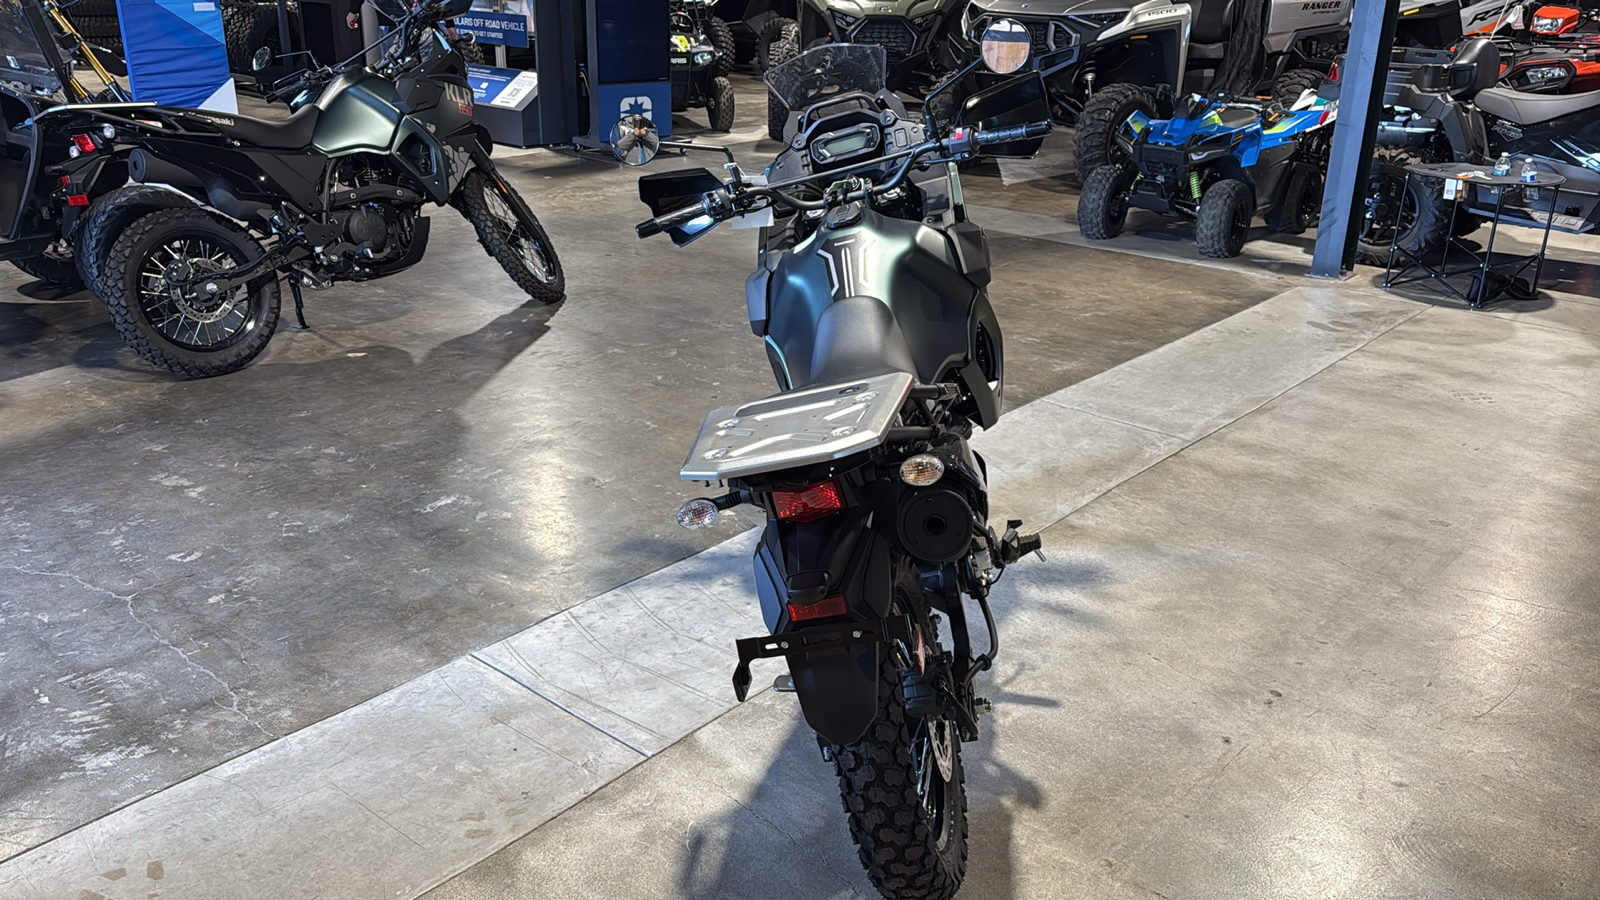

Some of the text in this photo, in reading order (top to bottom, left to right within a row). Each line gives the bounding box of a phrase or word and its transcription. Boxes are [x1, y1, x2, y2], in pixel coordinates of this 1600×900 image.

[1302, 1, 1341, 10] RANGER
[1148, 8, 1177, 16] 1500
[453, 17, 525, 31] OLARIS OFF ROAD VEHICLE
[444, 82, 474, 107] KLR
